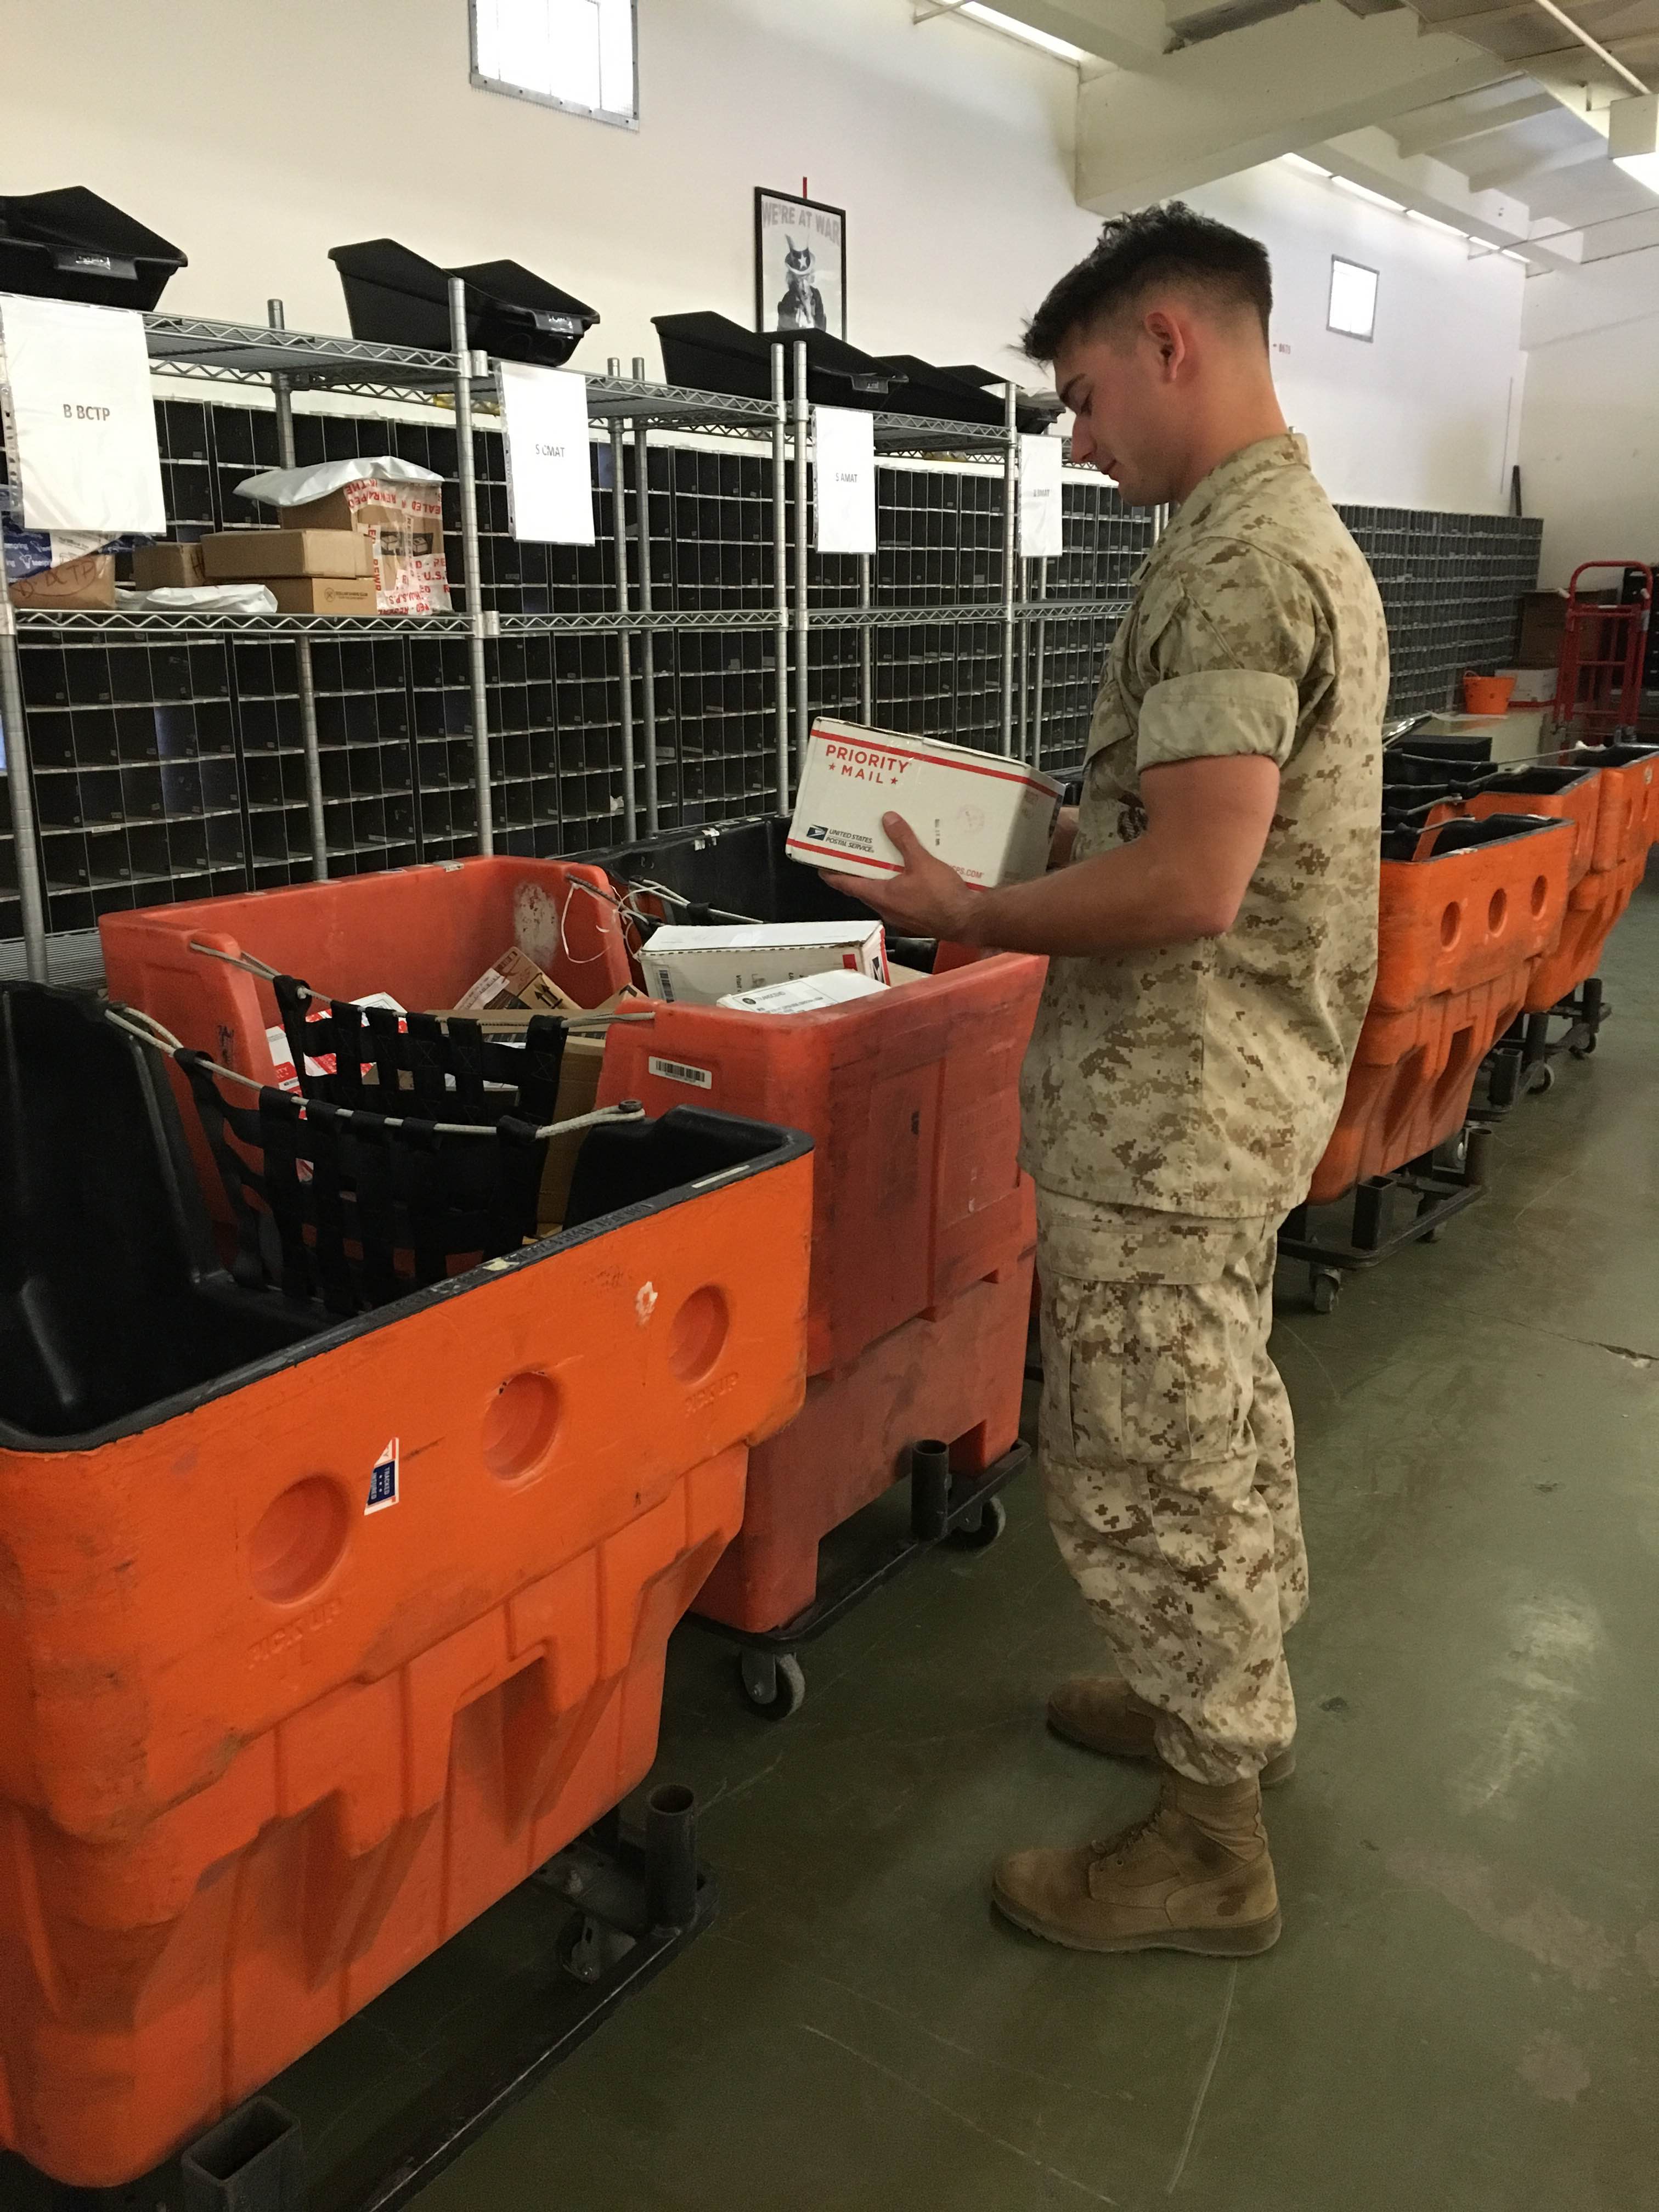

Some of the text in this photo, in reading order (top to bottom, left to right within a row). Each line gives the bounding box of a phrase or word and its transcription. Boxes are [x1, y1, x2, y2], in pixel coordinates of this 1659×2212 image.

[761, 201, 840, 247] WE'RE AT WAR
[63, 404, 110, 421] B BCTP
[535, 444, 540, 455] S
[840, 473, 857, 483] AMAT
[826, 744, 909, 773] PRIORITY
[842, 765, 883, 783] MAIL
[829, 829, 873, 844] UNITED STATES
[826, 837, 873, 853] POSTAL SERVICE
[951, 865, 983, 879] PS.COM
